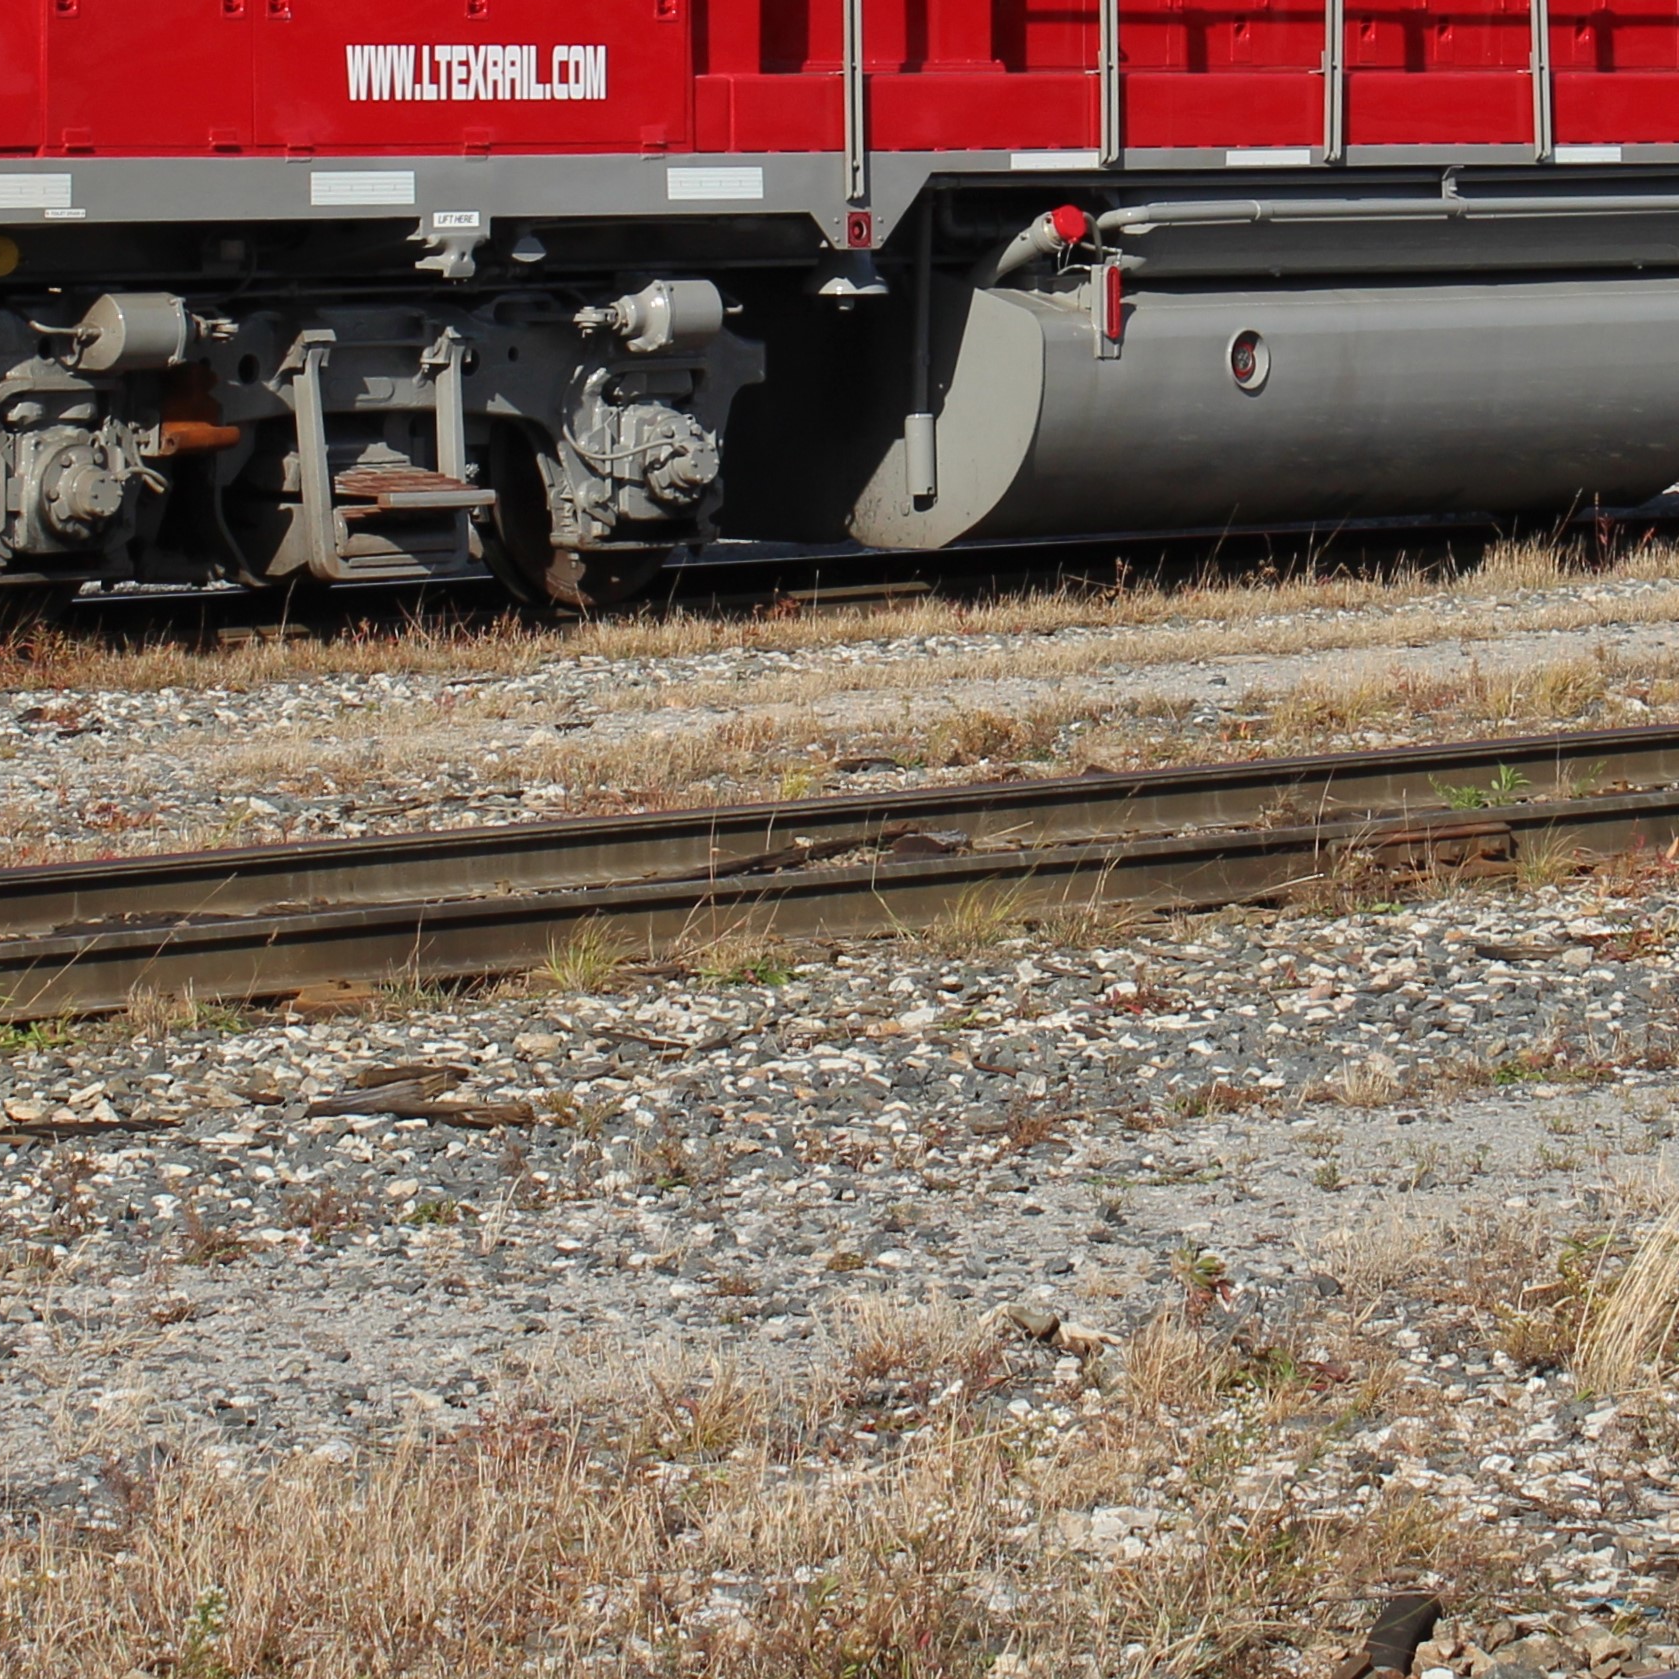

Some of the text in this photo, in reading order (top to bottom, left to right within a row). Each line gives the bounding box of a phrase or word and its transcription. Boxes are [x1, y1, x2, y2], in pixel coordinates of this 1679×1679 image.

[346, 45, 606, 101] WWW.LTEXRAIL.COM
[438, 214, 475, 224] LIFT HERE
